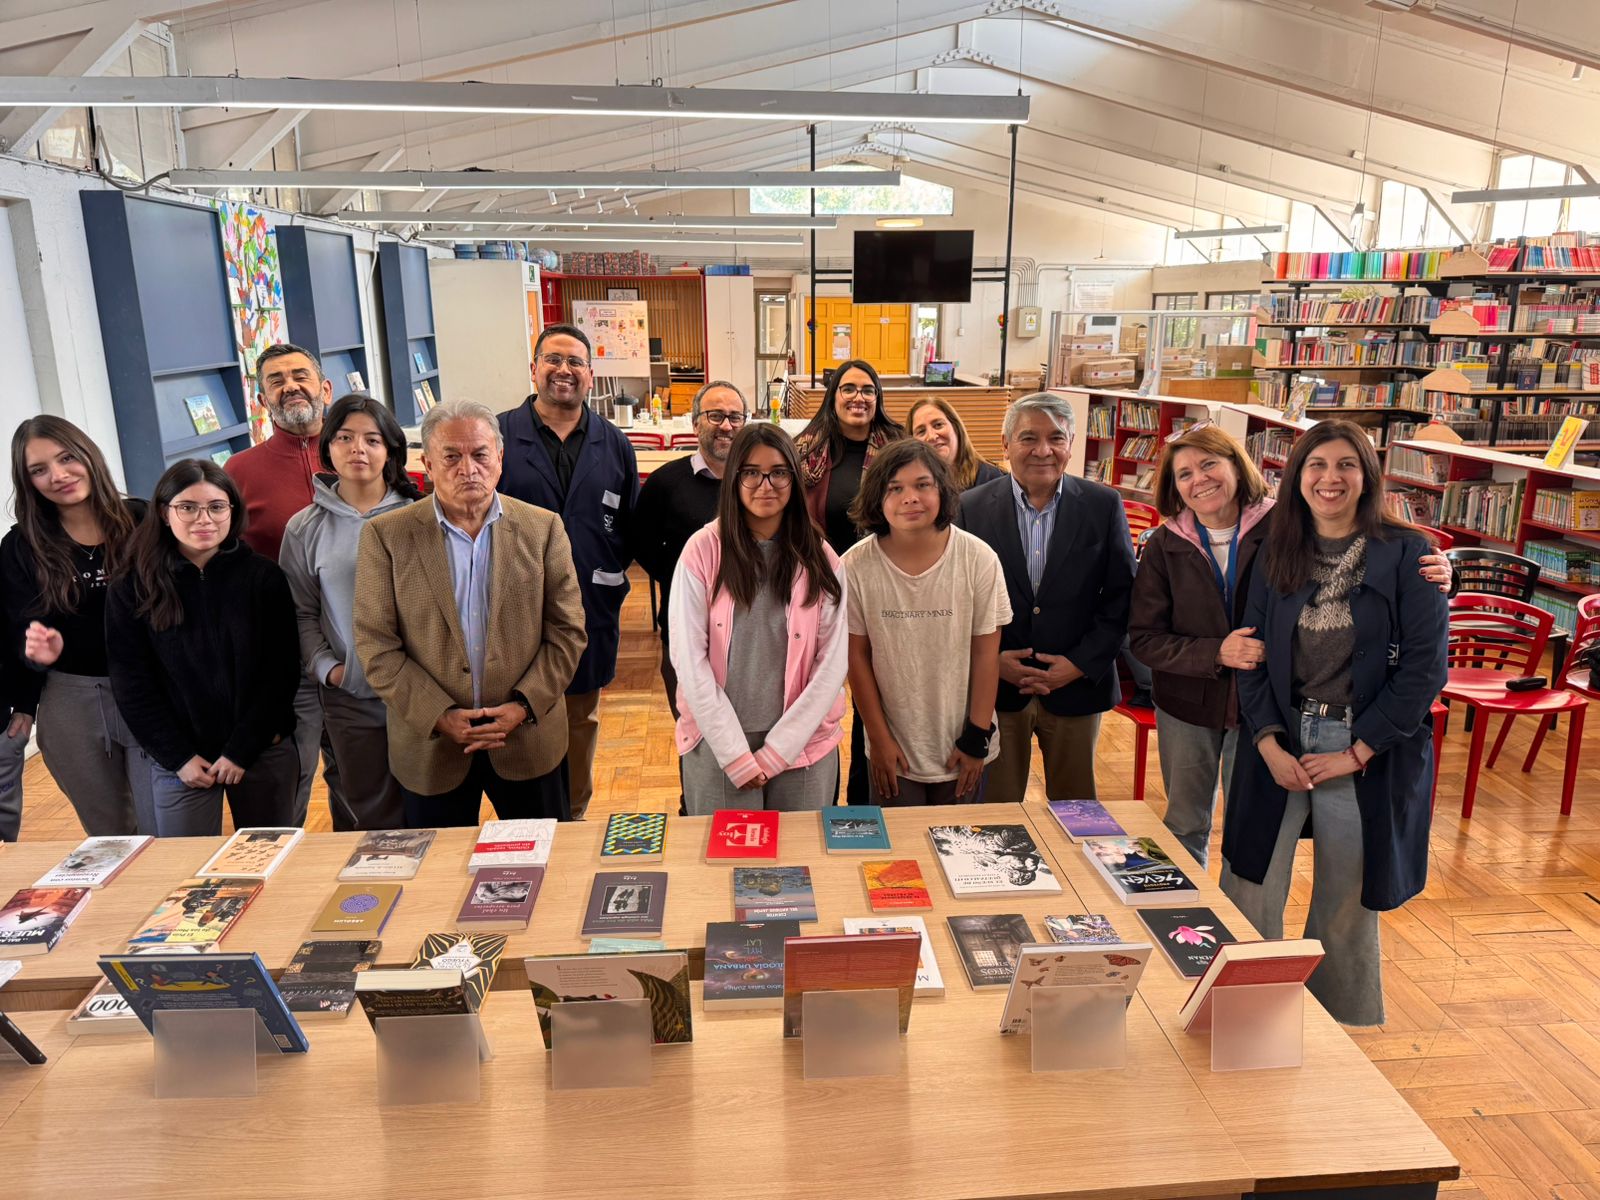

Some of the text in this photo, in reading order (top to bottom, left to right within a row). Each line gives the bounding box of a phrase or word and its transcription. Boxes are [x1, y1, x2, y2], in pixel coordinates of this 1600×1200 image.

[881, 609, 954, 618] IMAGINARY MINDS
[1120, 873, 1184, 885] SEVEN
